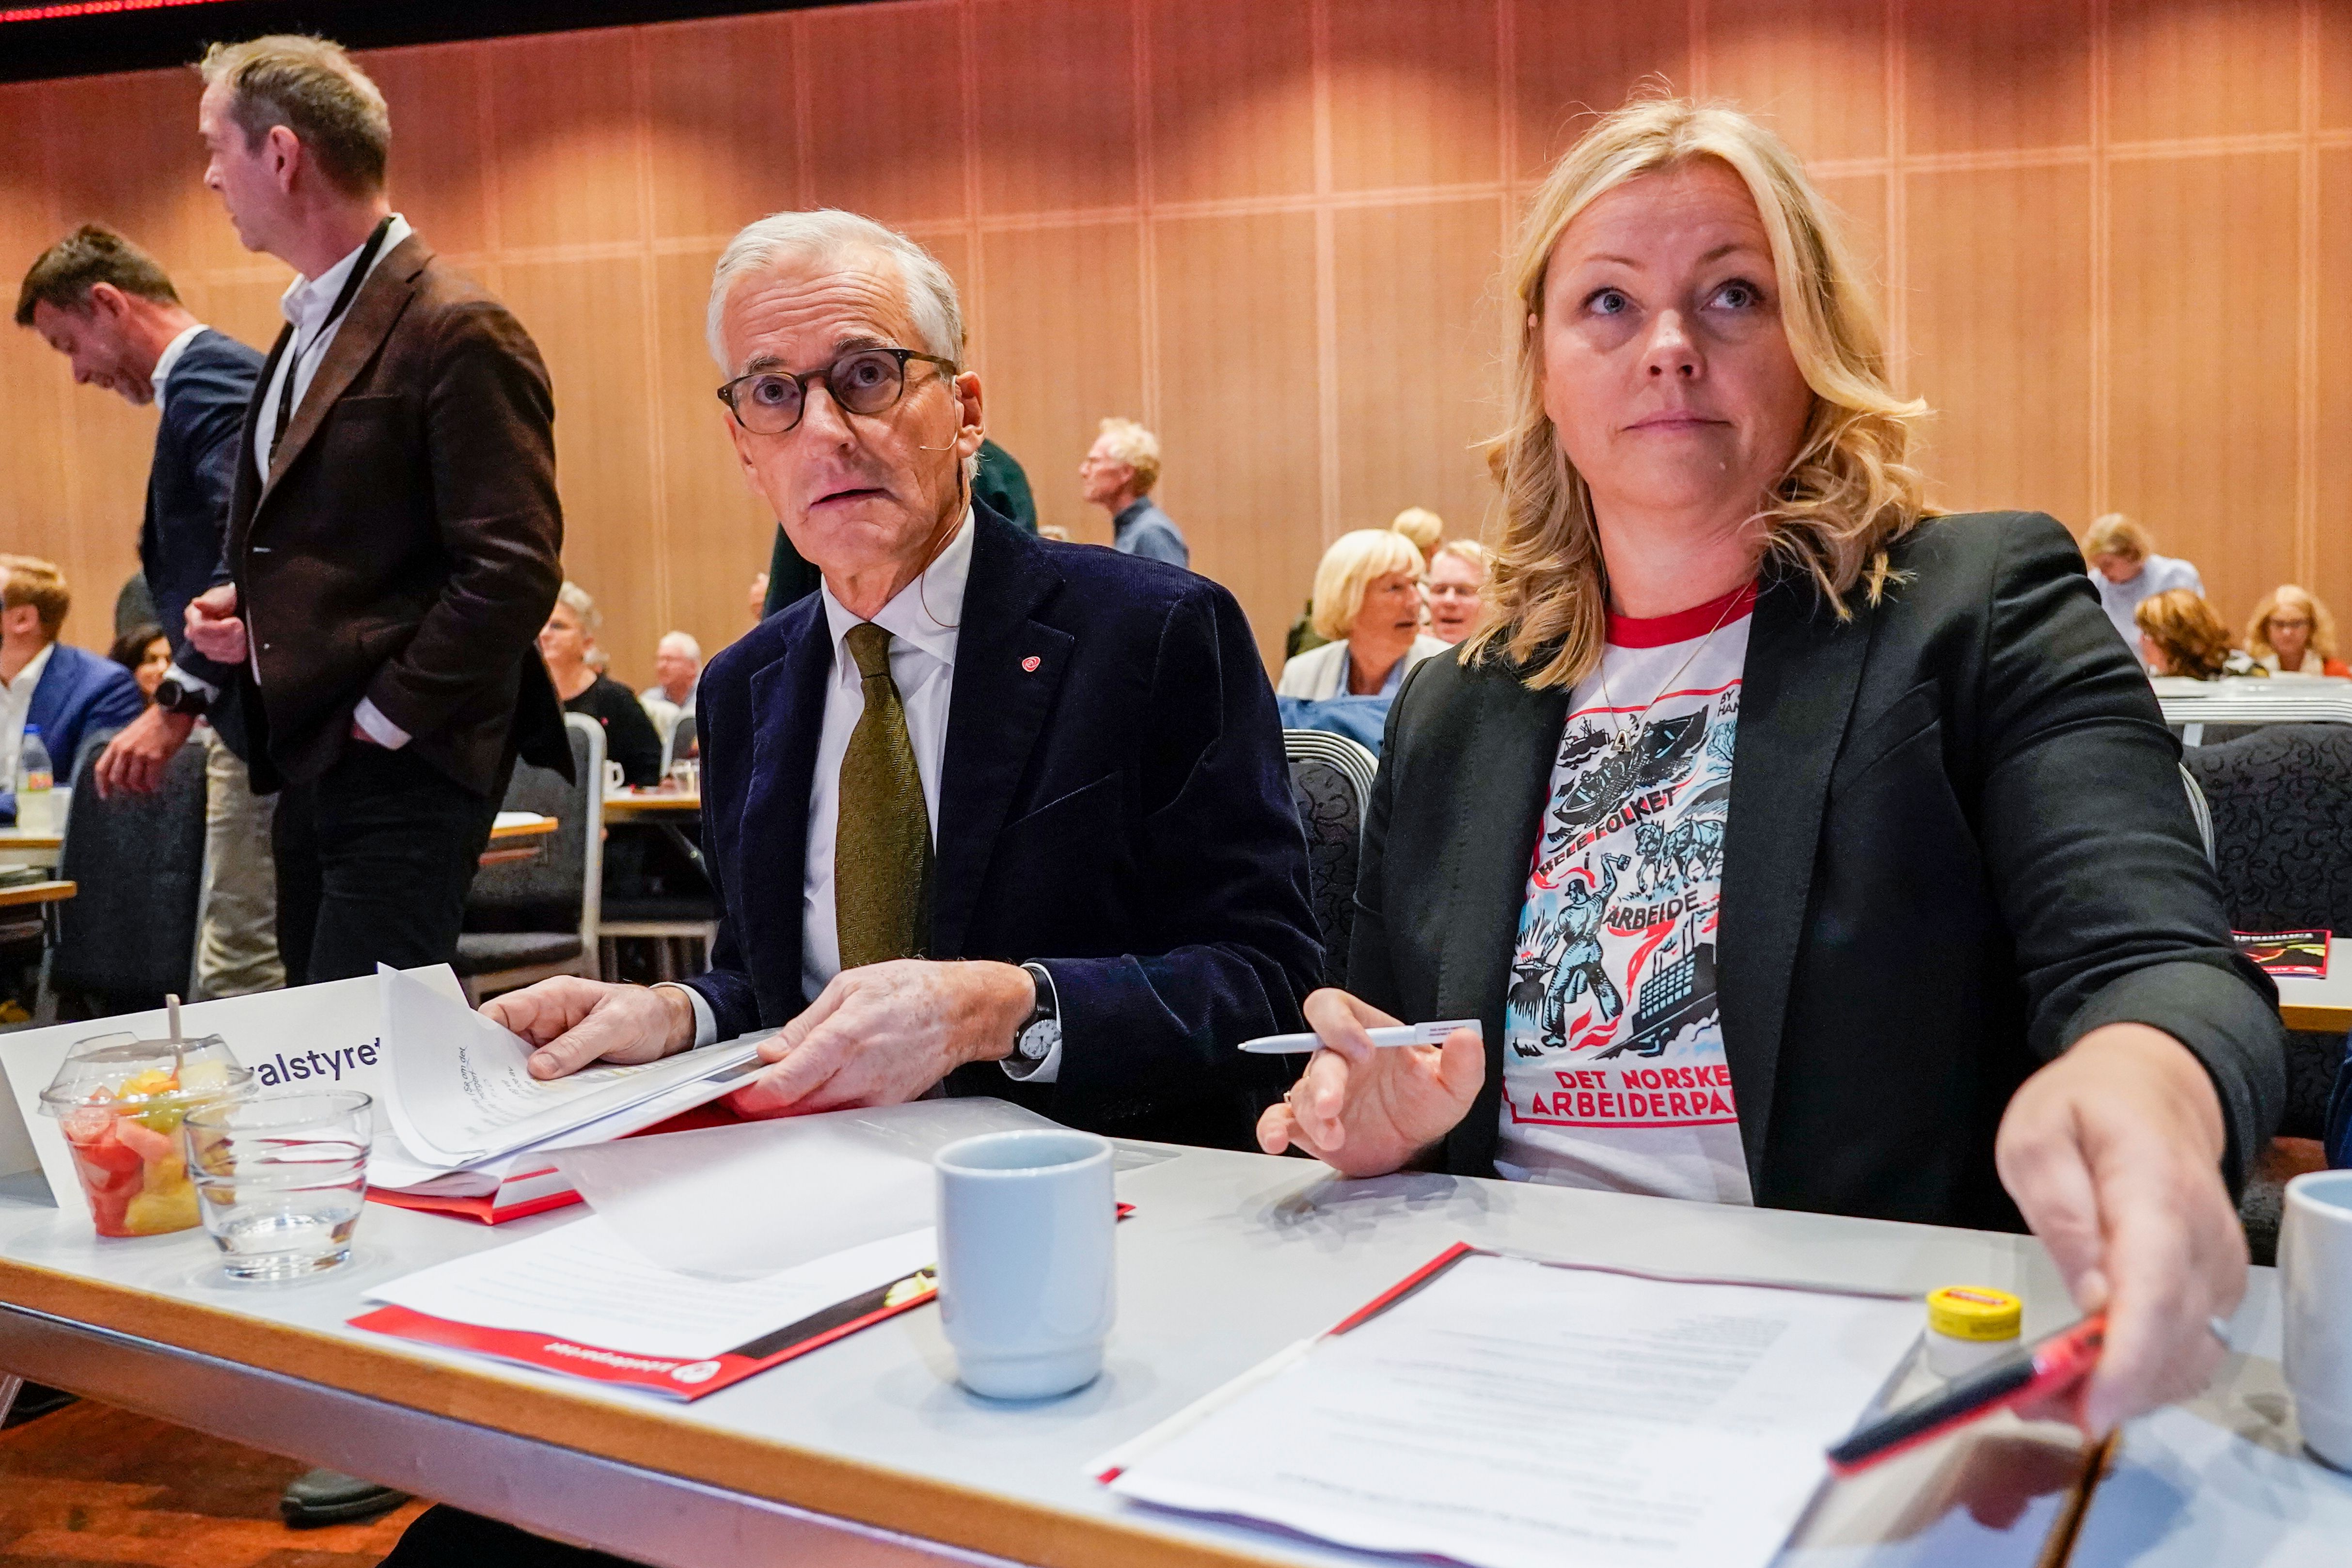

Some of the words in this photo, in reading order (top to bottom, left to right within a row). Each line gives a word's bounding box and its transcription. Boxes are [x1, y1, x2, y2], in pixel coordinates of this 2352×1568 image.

[1720, 689, 1735, 704] BY
[1537, 833, 1590, 876] HELE
[1594, 786, 1677, 840] FOLKET
[1602, 890, 1701, 930] ARBEIDE
[246, 1037, 380, 1086] alstyre
[1555, 1071, 1606, 1089] DET
[1621, 1064, 1732, 1090] NORSKE
